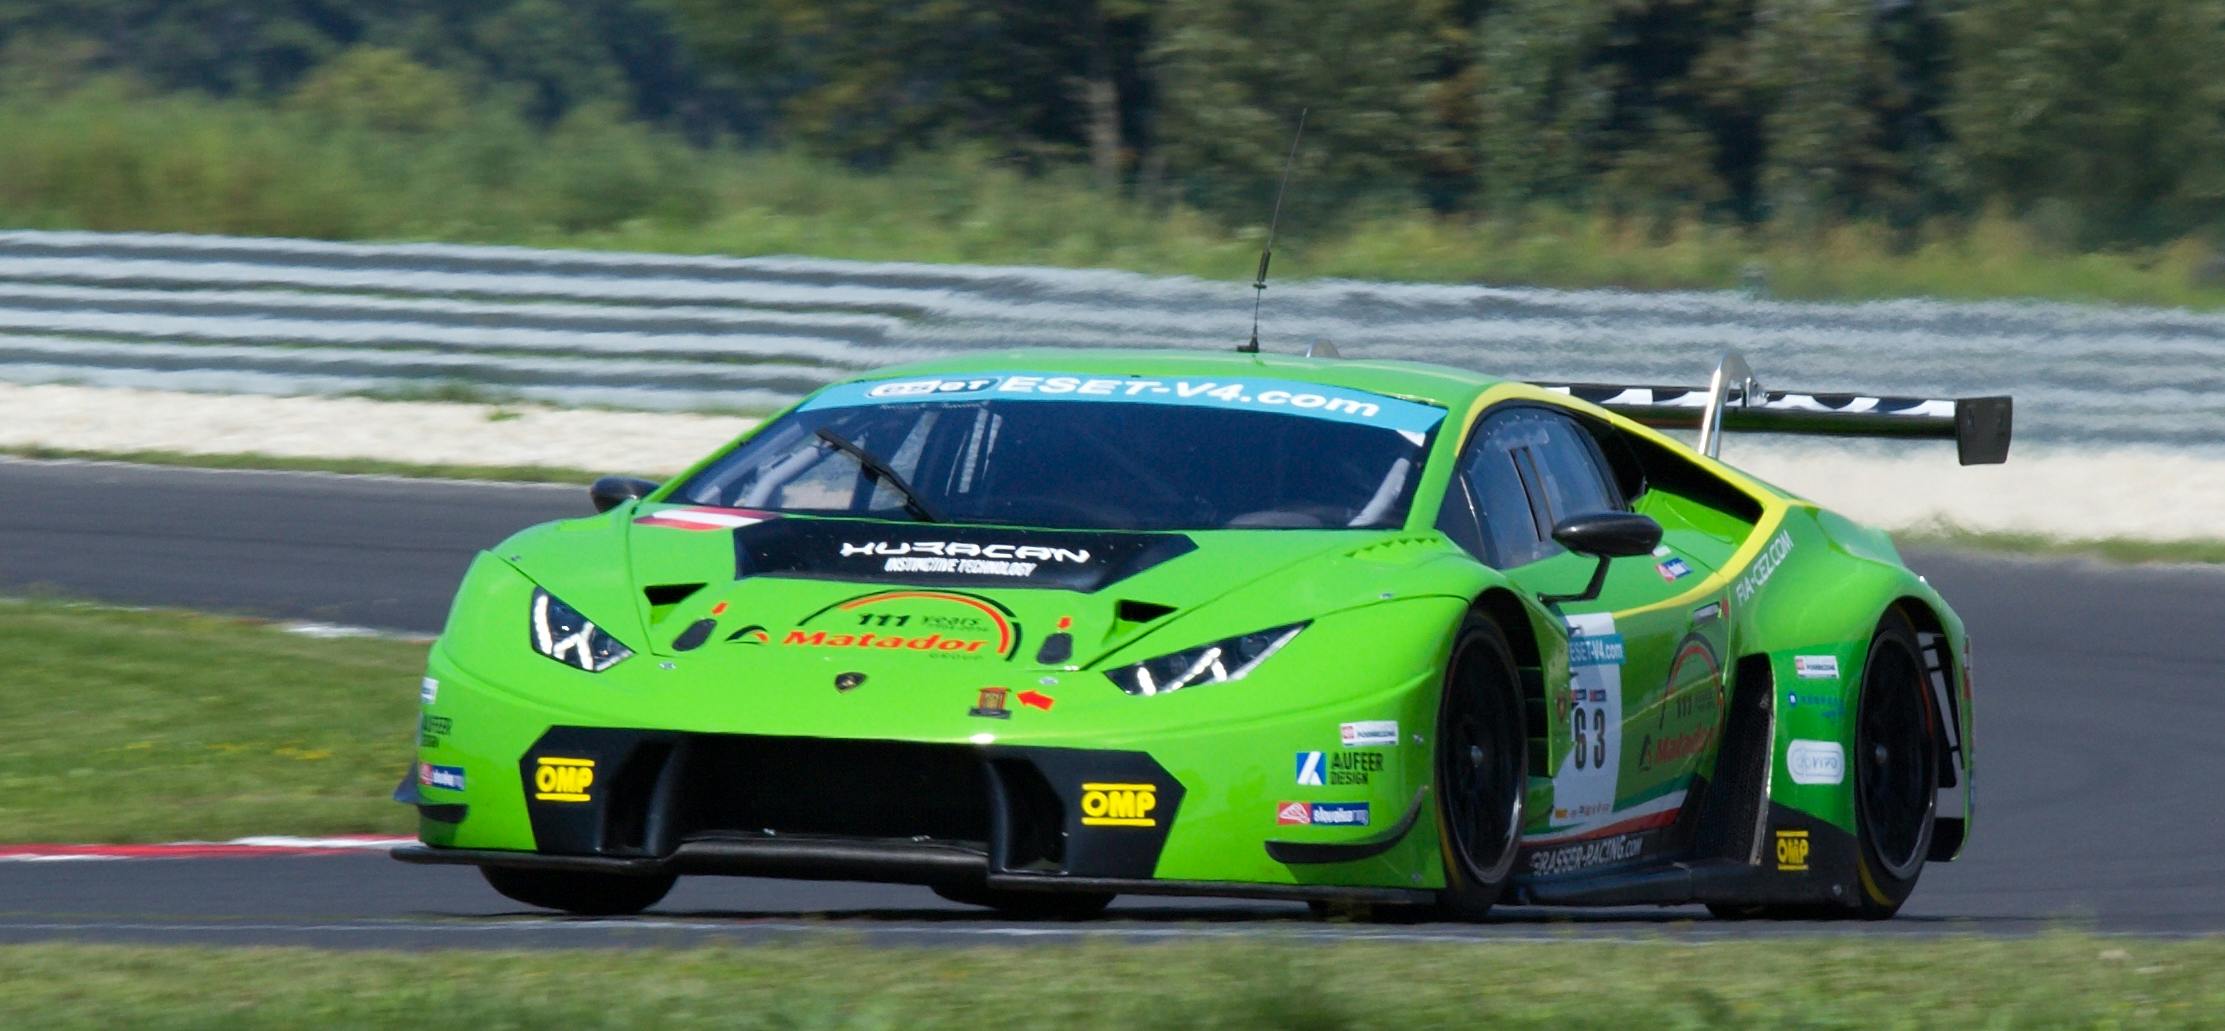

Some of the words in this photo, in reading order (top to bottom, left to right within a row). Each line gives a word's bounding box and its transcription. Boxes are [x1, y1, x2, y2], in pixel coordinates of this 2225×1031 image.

[999, 376, 1380, 417] ESET-V4.com
[840, 541, 1091, 564] HURACAN
[884, 556, 959, 573] INSTINCTIVE
[958, 559, 1038, 577] TECHNOLOGY
[858, 613, 911, 627] 111
[783, 631, 989, 652] Matador
[1573, 707, 1606, 770] 63
[1330, 751, 1385, 772] AUFEER
[535, 764, 594, 794] OMP
[1330, 771, 1369, 786] DESIGN
[1082, 790, 1156, 819] OMP
[1776, 837, 1810, 865] OMP
